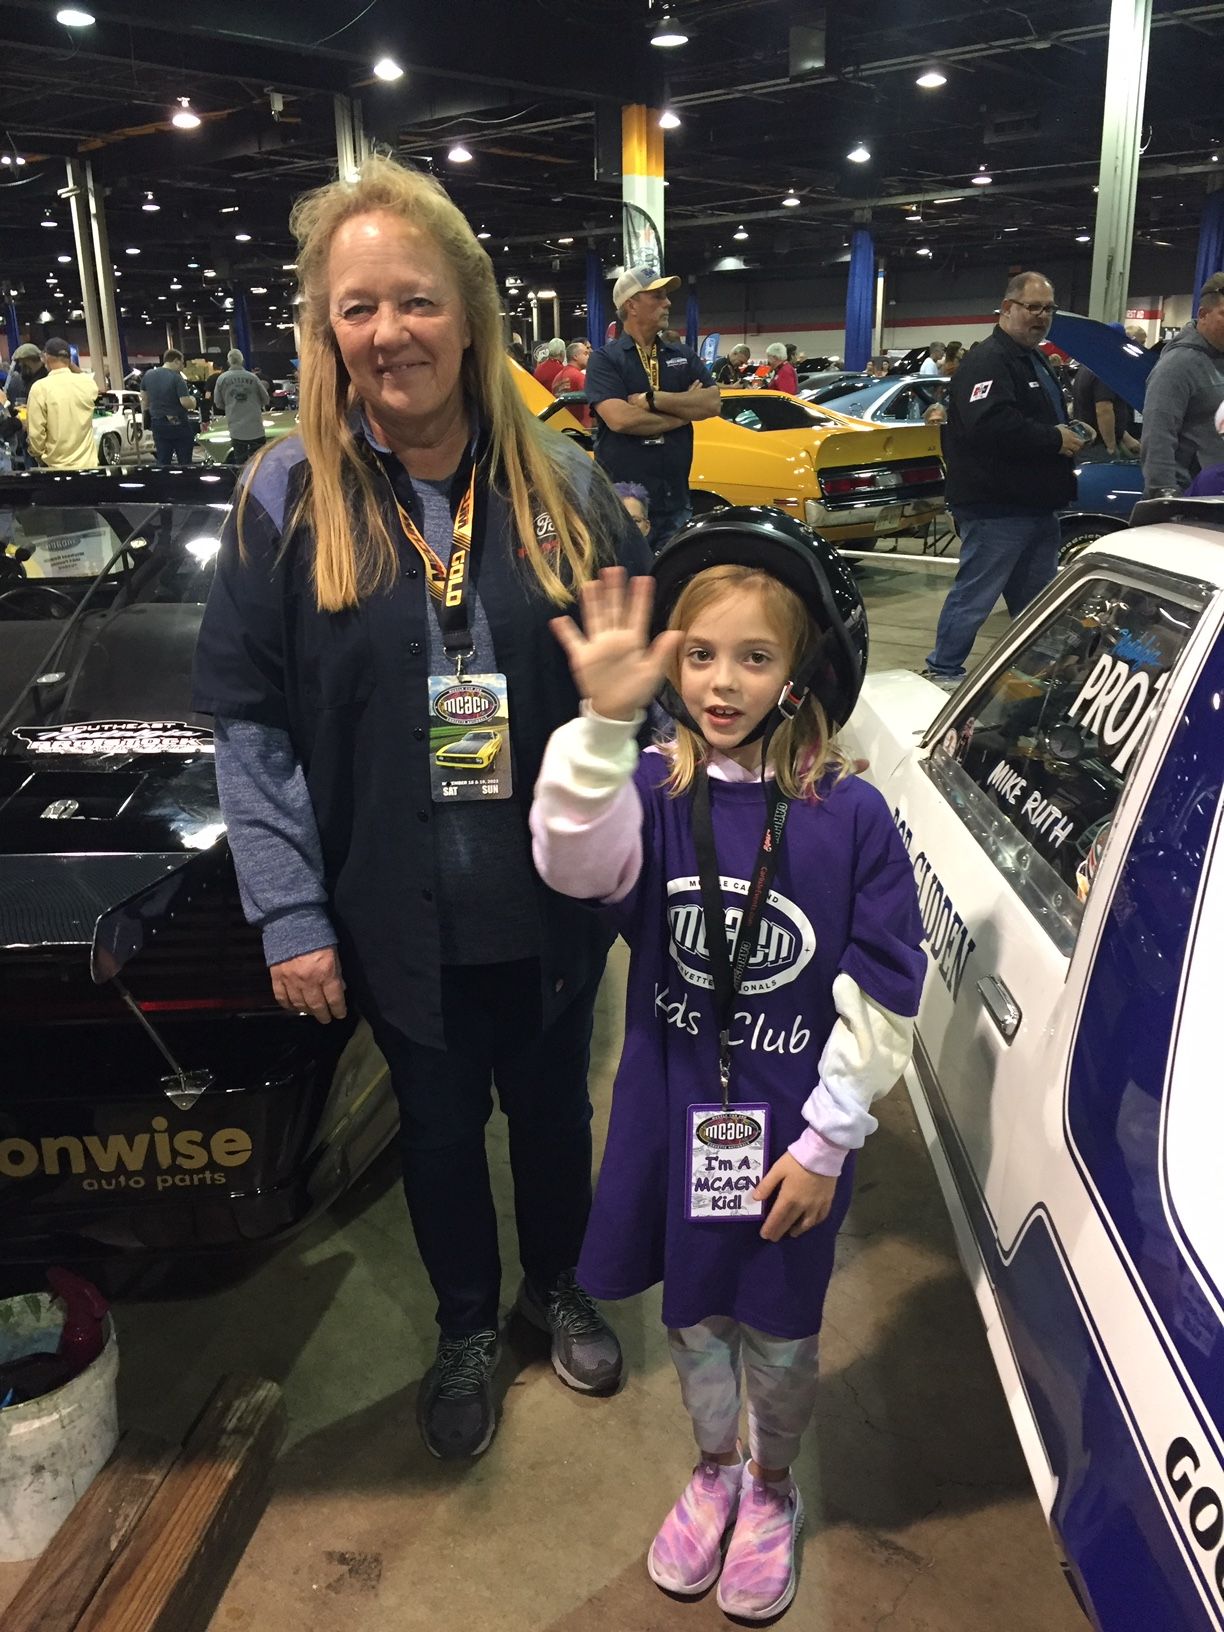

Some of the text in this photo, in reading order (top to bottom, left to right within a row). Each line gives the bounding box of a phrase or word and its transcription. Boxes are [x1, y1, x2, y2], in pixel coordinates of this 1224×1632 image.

[536, 514, 555, 536] Fo
[445, 549, 466, 607] GOLD
[60, 723, 176, 732] SOUTHEAST
[443, 784, 498, 796] SAT SUN
[987, 760, 1074, 849] MIKE RUTH
[733, 882, 751, 892] CA
[742, 979, 778, 992] ONALS
[727, 1011, 811, 1054] Club
[0, 1116, 253, 1177] onwise
[704, 1156, 751, 1171] I'm A
[82, 1170, 227, 1191] auto parts
[695, 1176, 760, 1192] MCACN
